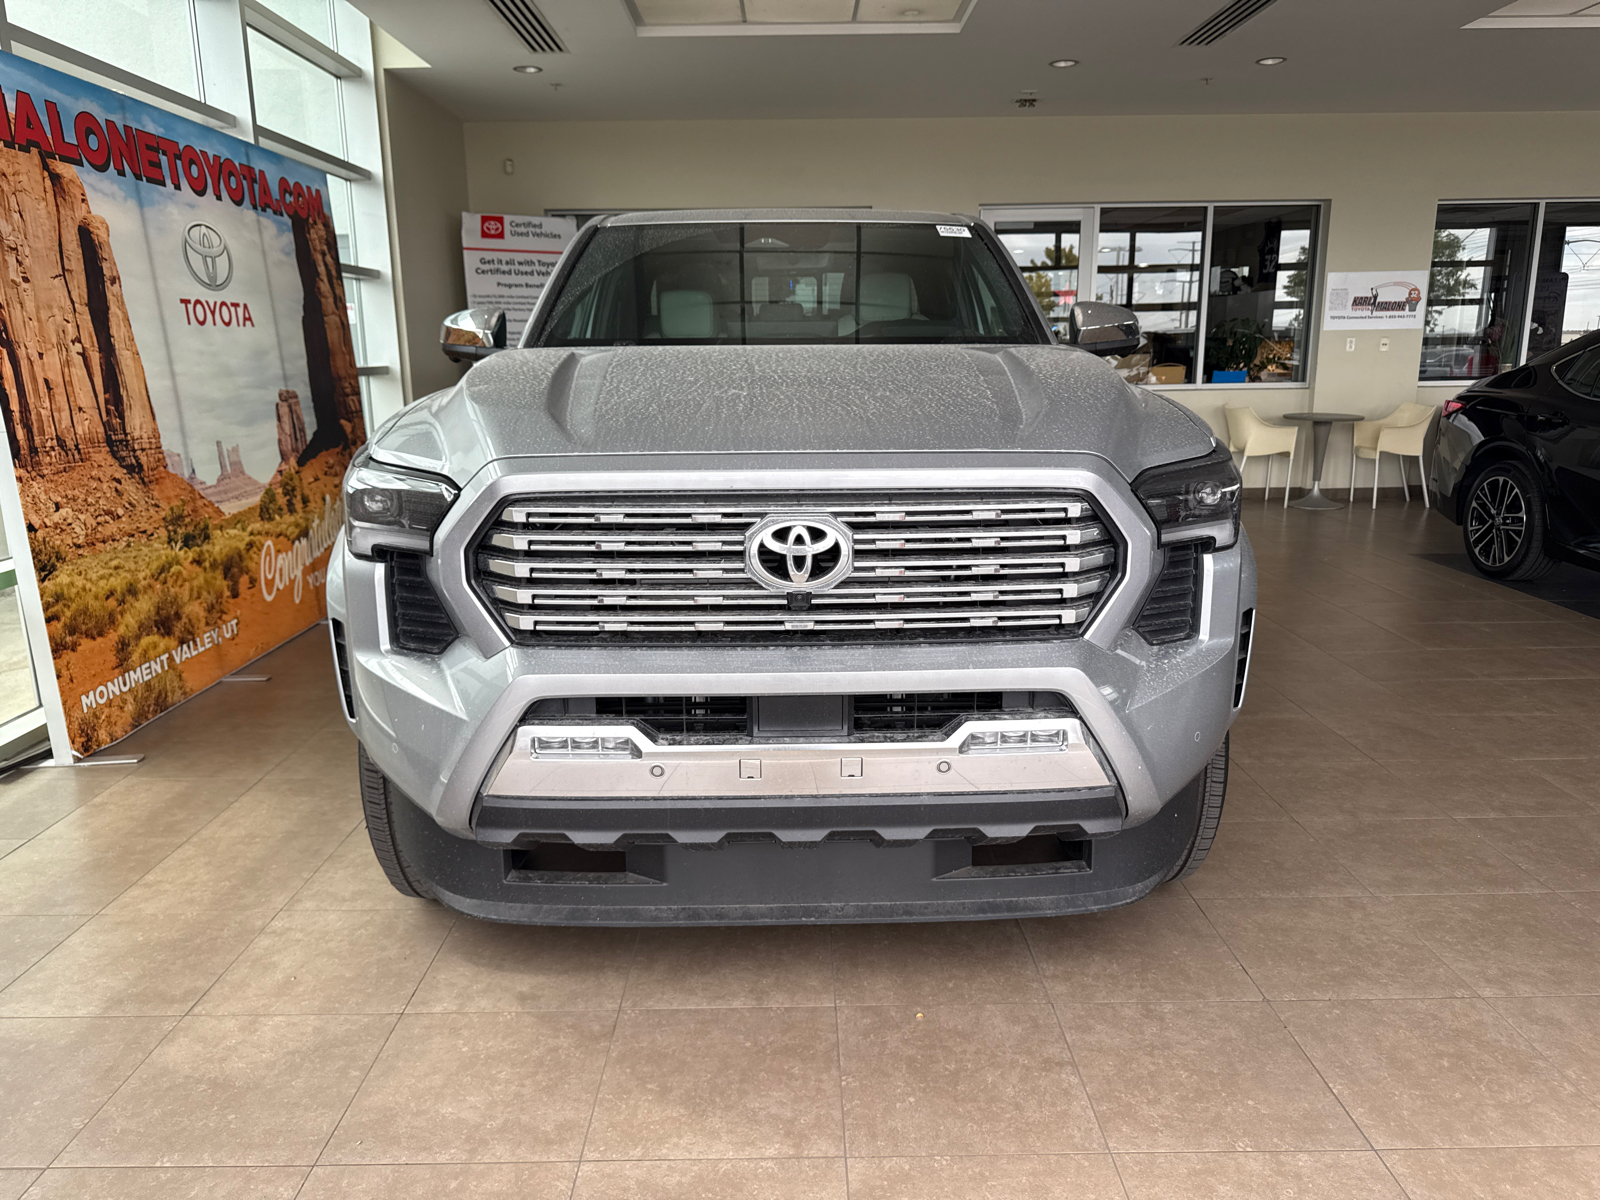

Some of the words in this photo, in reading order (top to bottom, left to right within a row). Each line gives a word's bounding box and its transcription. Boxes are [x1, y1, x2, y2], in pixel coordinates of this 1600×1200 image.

[509, 220, 543, 230] Certified
[510, 230, 531, 238] Used
[531, 230, 562, 239] Vehicles
[479, 257, 495, 266] Get
[496, 258, 503, 266] it
[504, 258, 516, 267] all
[517, 258, 536, 267] with
[537, 259, 559, 268] Toyo
[1263, 254, 1278, 273] 32
[475, 267, 512, 276] Certified
[513, 268, 535, 277] Used
[496, 282, 524, 290] Program
[1352, 296, 1372, 307] KARL
[1375, 301, 1407, 312] MALONE
[179, 298, 255, 327] TOYOTA
[80, 653, 170, 713] MONUMENT
[171, 627, 222, 665] VALLEY,
[222, 619, 239, 638] UT
